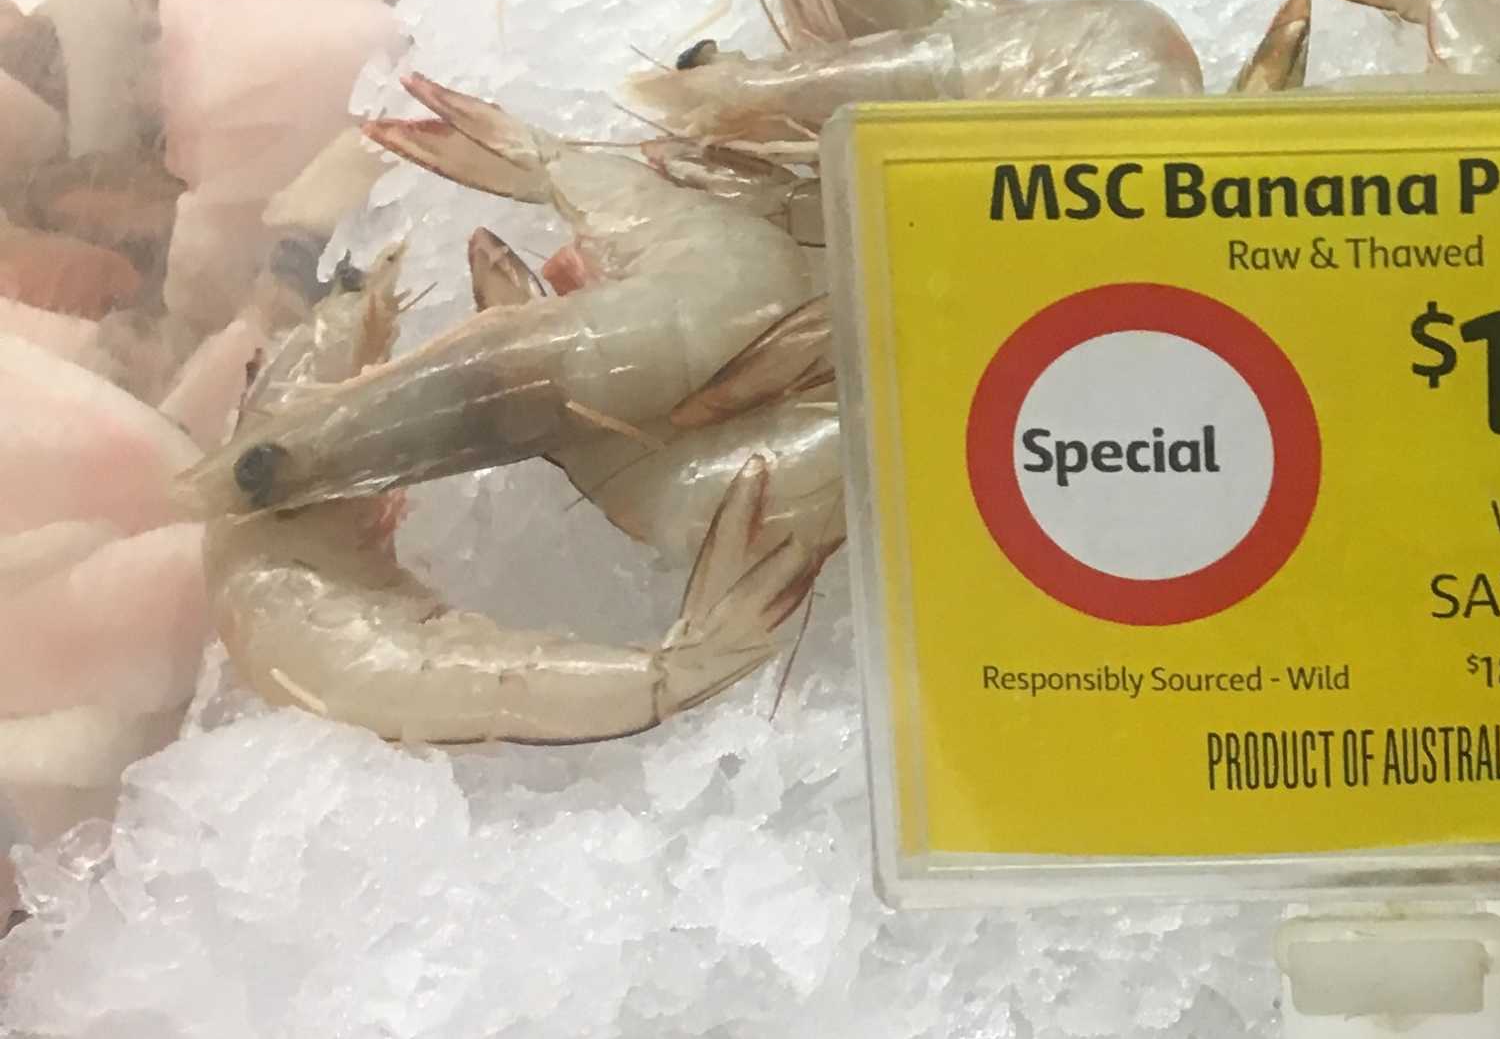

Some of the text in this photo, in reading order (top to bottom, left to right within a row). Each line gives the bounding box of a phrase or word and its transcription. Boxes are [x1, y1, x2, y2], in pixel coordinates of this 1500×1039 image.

[989, 162, 1145, 222] MSC
[1163, 162, 1439, 219] Banana
[1228, 234, 1484, 271] Raw & Thawed
[1021, 424, 1221, 488] Special
[983, 665, 1144, 699] Responsibly
[1151, 665, 1263, 692] Sourced
[1286, 664, 1350, 691] Wild
[1207, 730, 1335, 791] PRODUCT
[1342, 728, 1375, 788] OF
